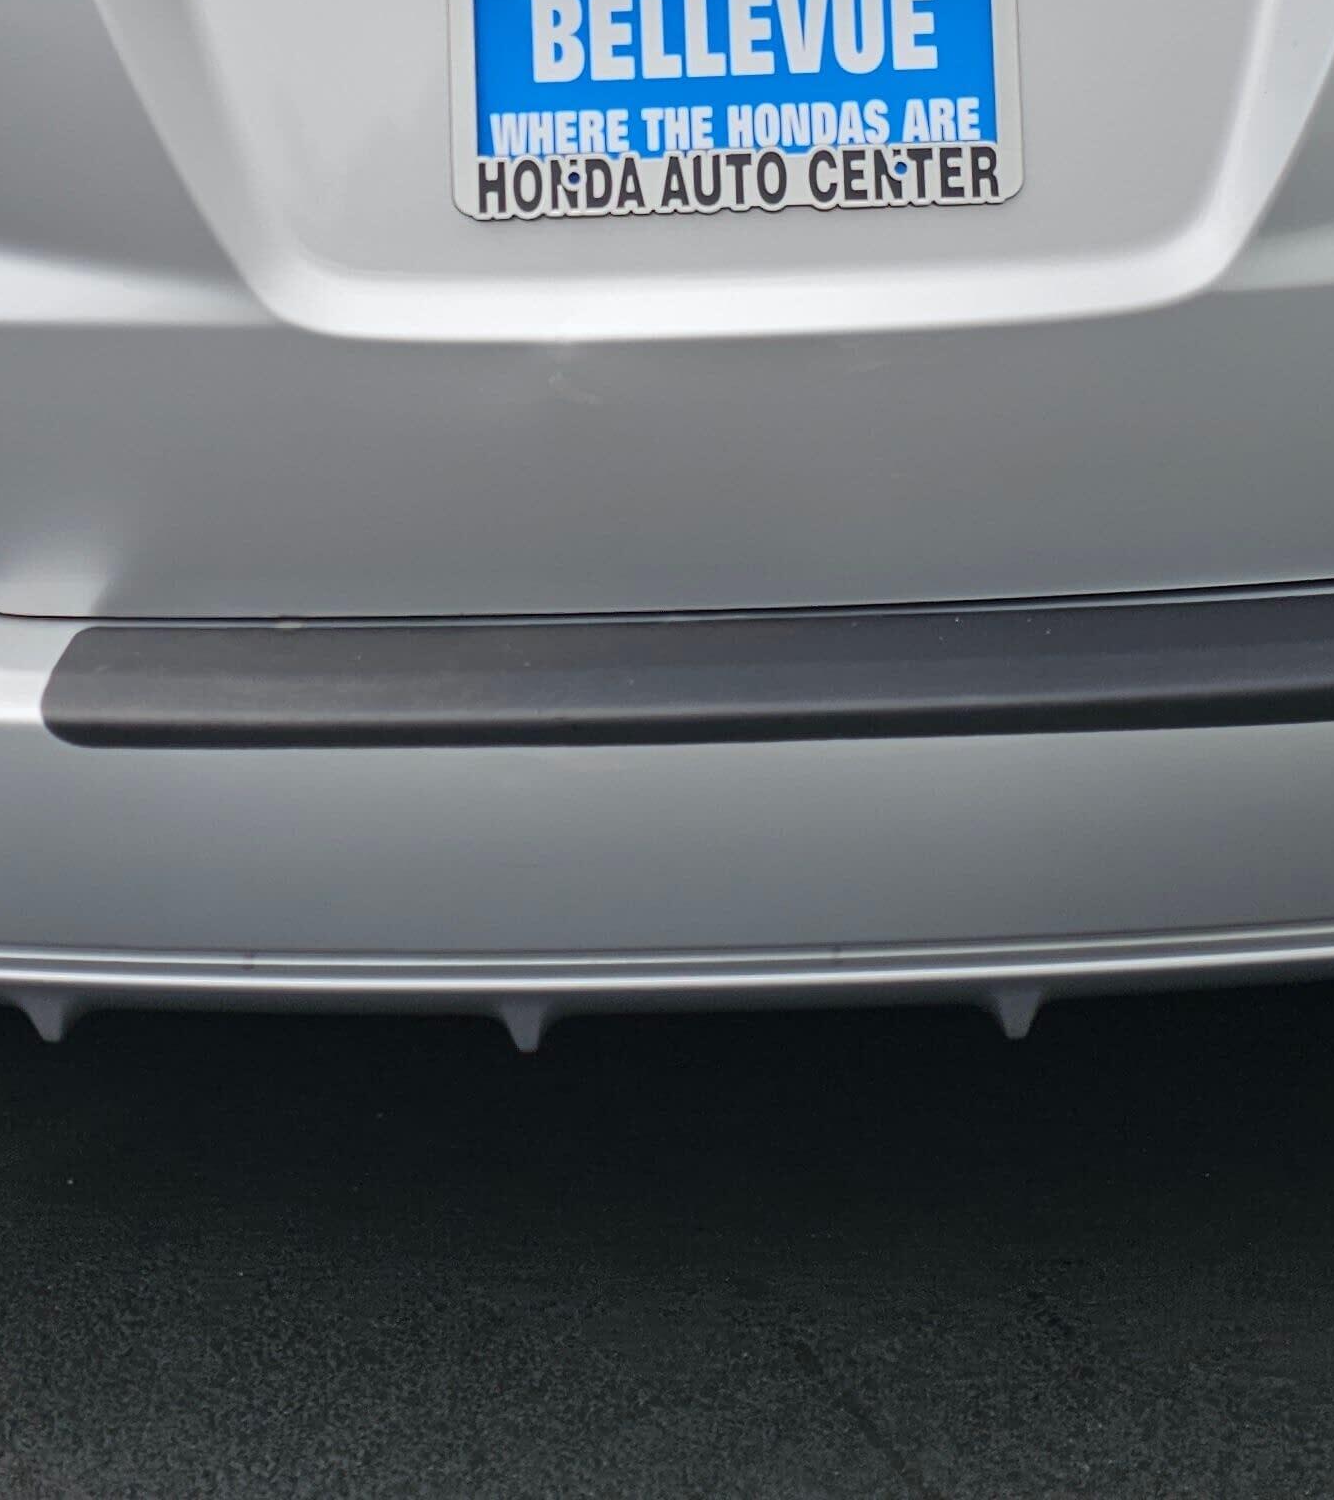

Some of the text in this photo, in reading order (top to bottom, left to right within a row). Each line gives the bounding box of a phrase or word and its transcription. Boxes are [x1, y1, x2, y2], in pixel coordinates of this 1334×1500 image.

[490, 97, 981, 157] WHERE THE HONDAS ARE
[478, 146, 999, 214] HONDA AUTO CENTER
